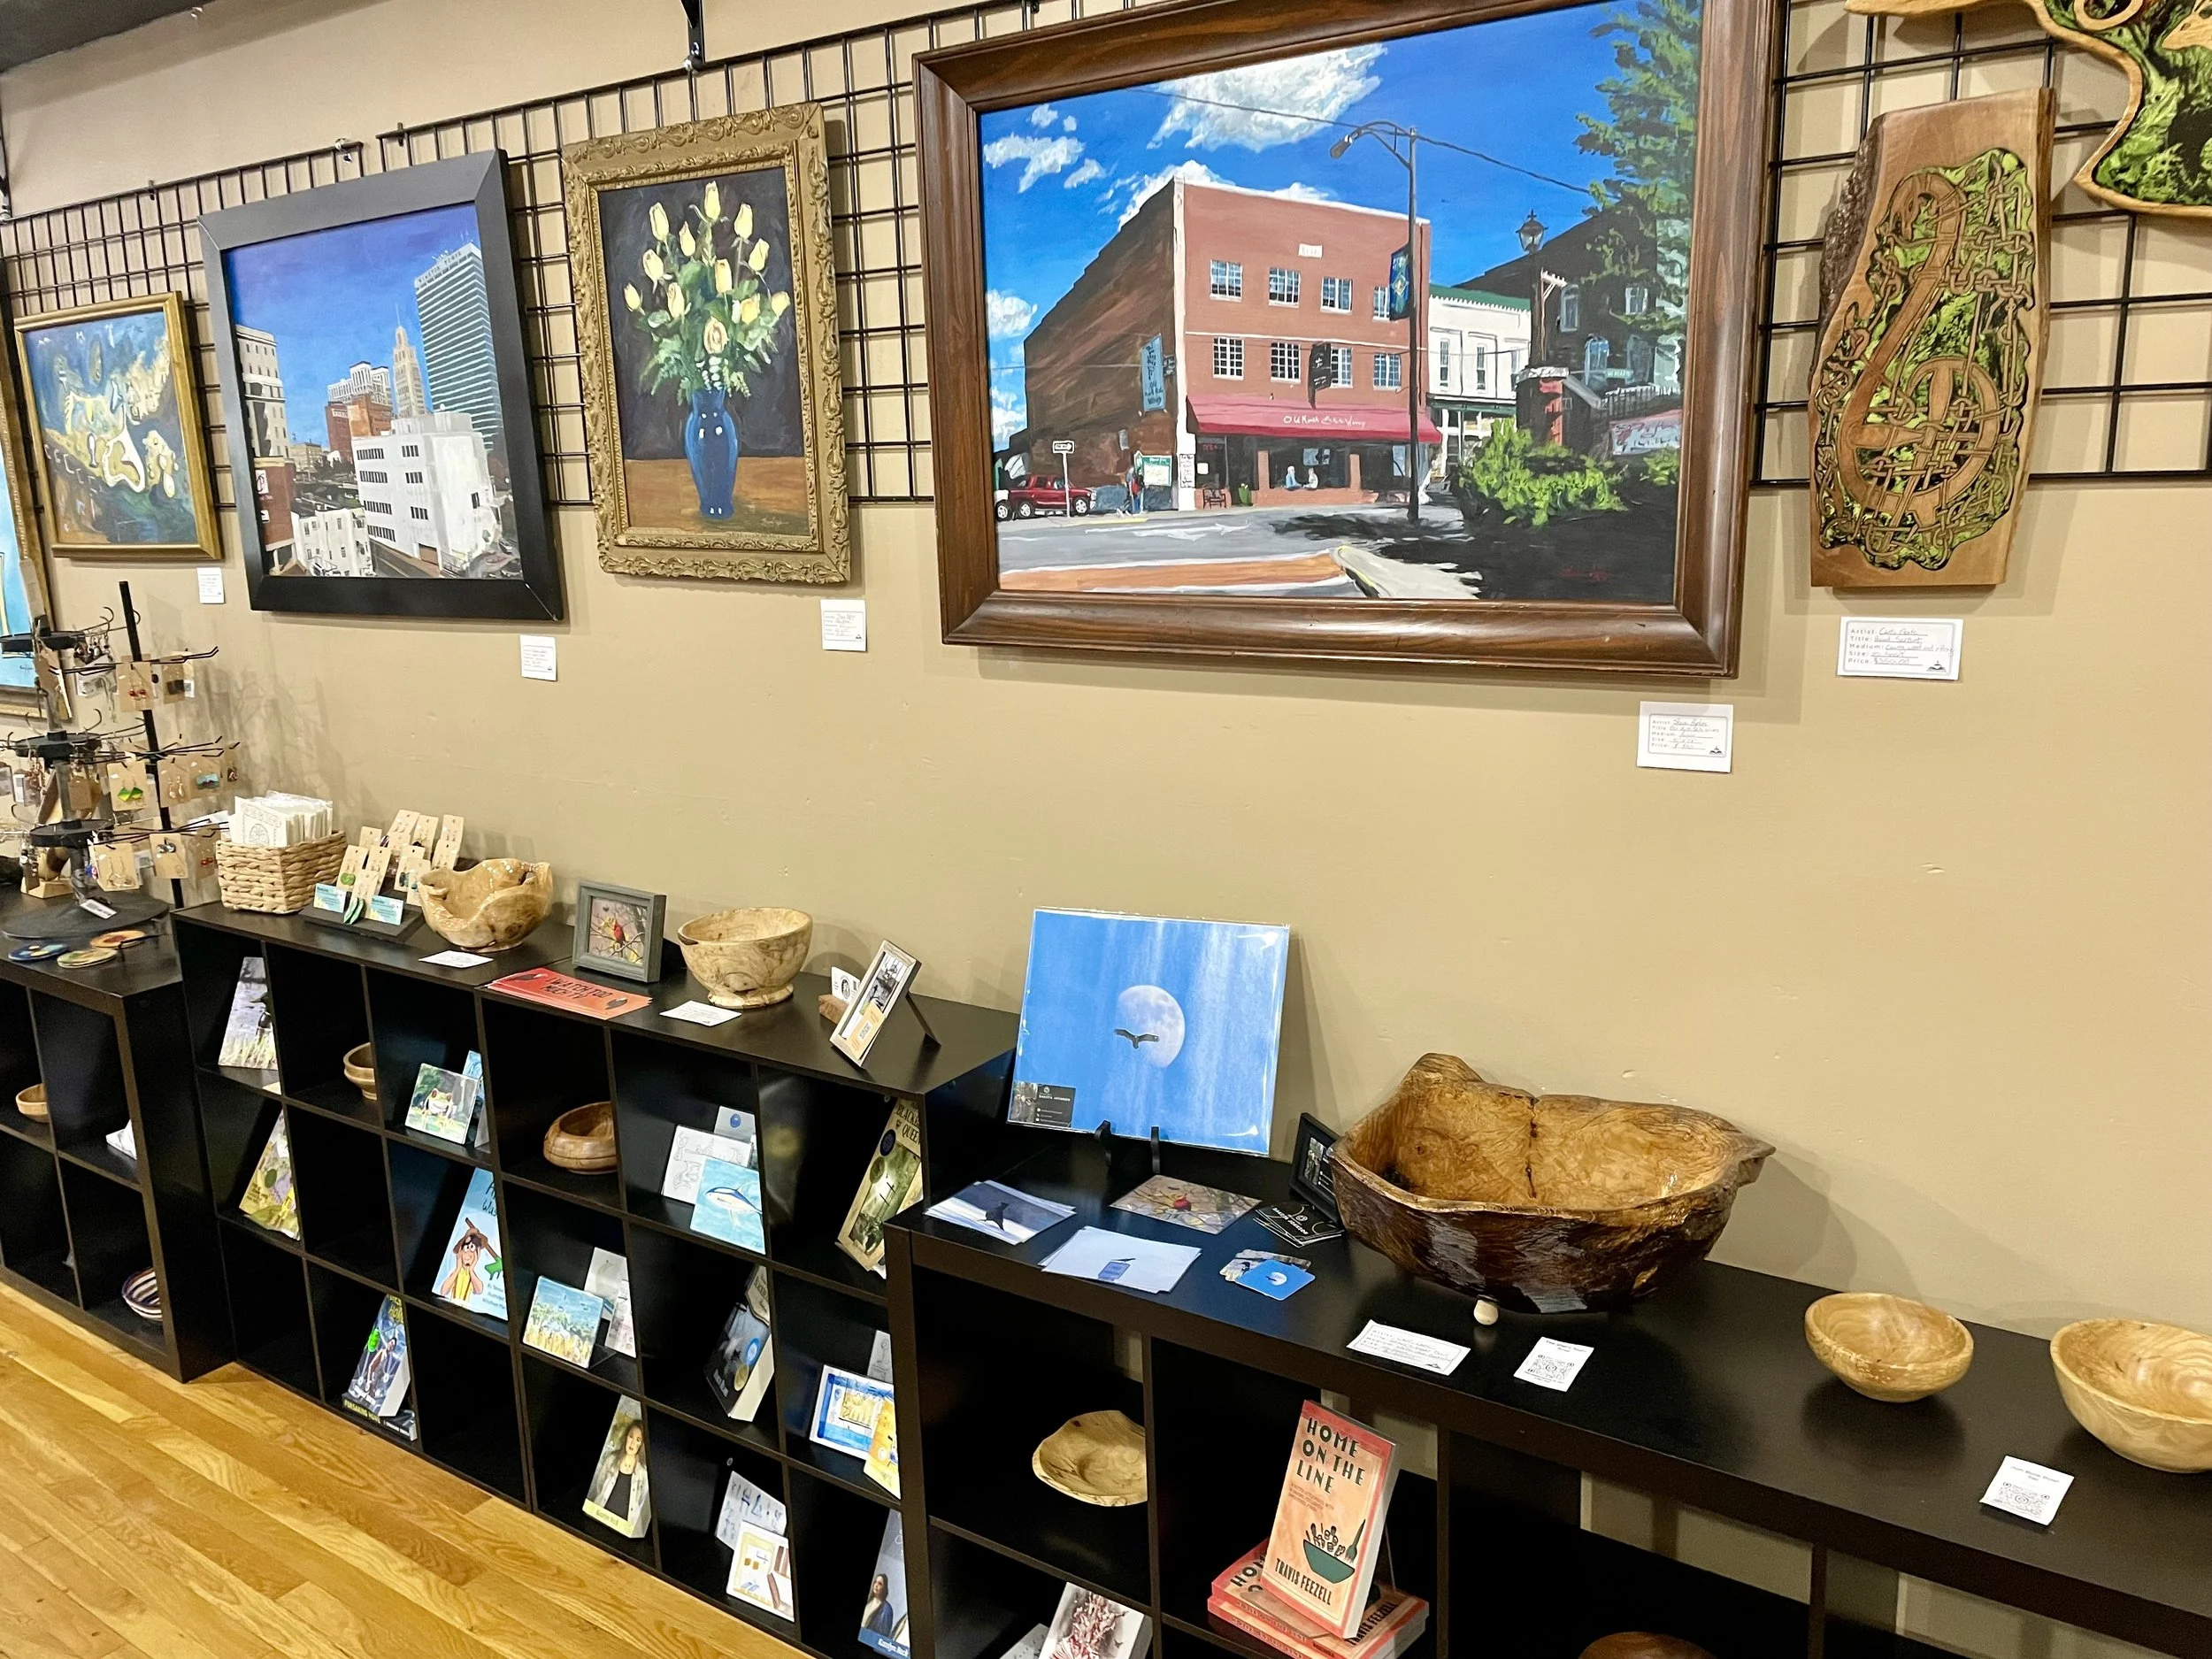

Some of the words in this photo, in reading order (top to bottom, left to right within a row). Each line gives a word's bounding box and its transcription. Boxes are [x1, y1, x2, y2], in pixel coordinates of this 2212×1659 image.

[1307, 1417, 1359, 1457] HOME
[1296, 1459, 1334, 1494] LINE
[1302, 1440, 1327, 1464] ON
[1333, 1455, 1365, 1486] THE
[1275, 1558, 1301, 1586] TRAVIS
[1300, 1575, 1332, 1606] FEEZELL
[1367, 1601, 1399, 1625] FEEZELL
